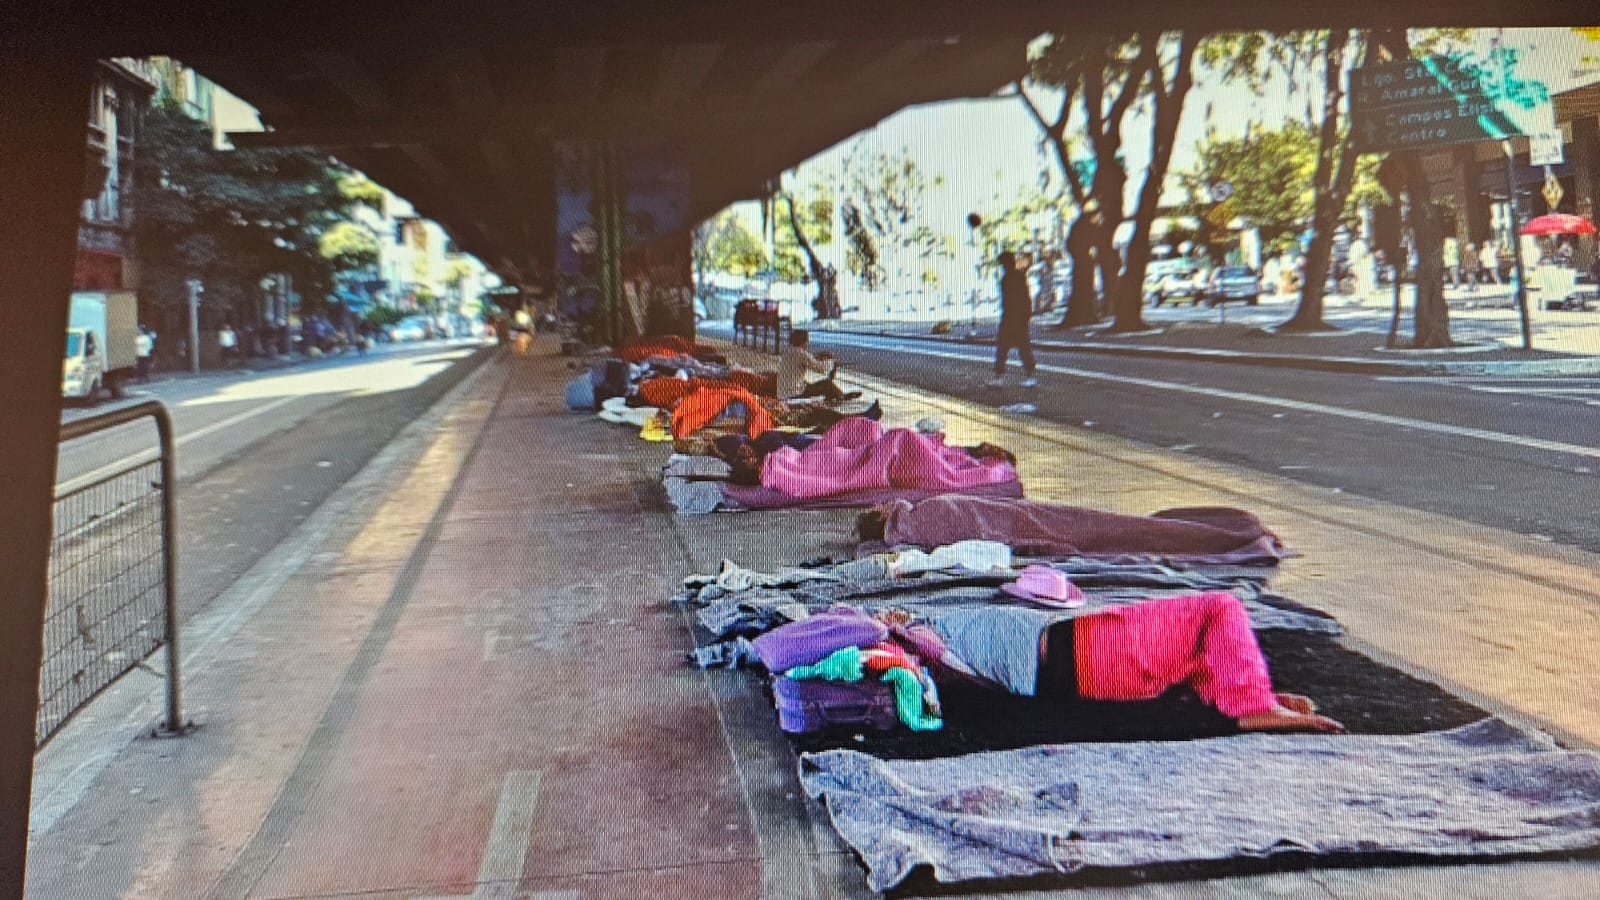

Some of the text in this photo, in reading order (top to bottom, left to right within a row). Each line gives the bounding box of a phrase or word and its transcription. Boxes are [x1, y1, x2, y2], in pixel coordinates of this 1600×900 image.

[1381, 83, 1442, 101] Amaral
[1448, 78, 1478, 92] Gur
[1385, 109, 1452, 127] Campos
[1386, 128, 1447, 144] Centro
